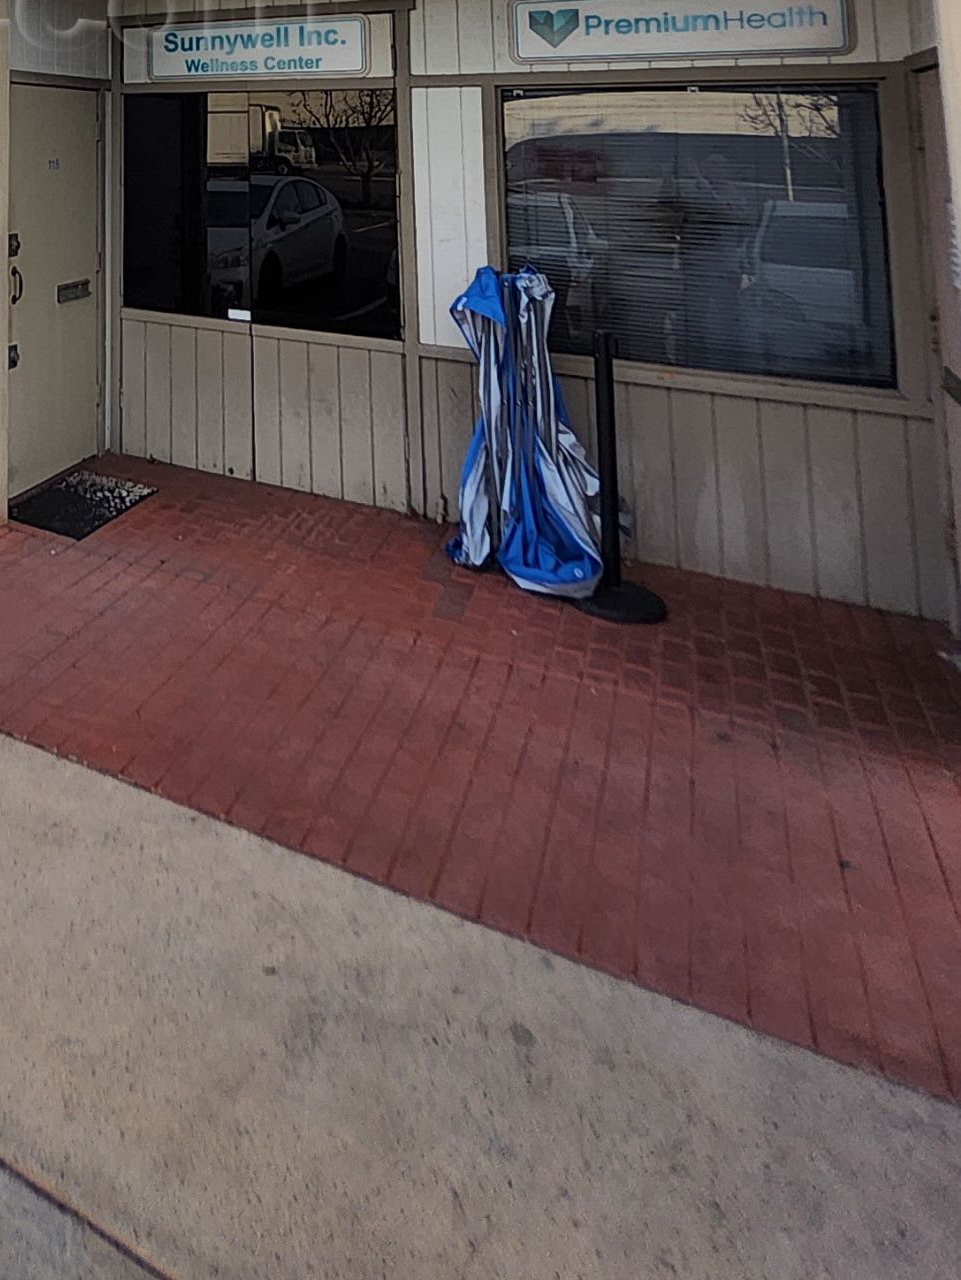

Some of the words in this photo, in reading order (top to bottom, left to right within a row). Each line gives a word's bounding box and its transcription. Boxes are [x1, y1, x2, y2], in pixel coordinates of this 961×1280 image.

[583, 5, 828, 36] PremiumHealth
[163, 27, 289, 55] Sunnywell
[298, 25, 347, 47] Inc.
[185, 57, 259, 73] Wellness
[263, 56, 323, 71] Center
